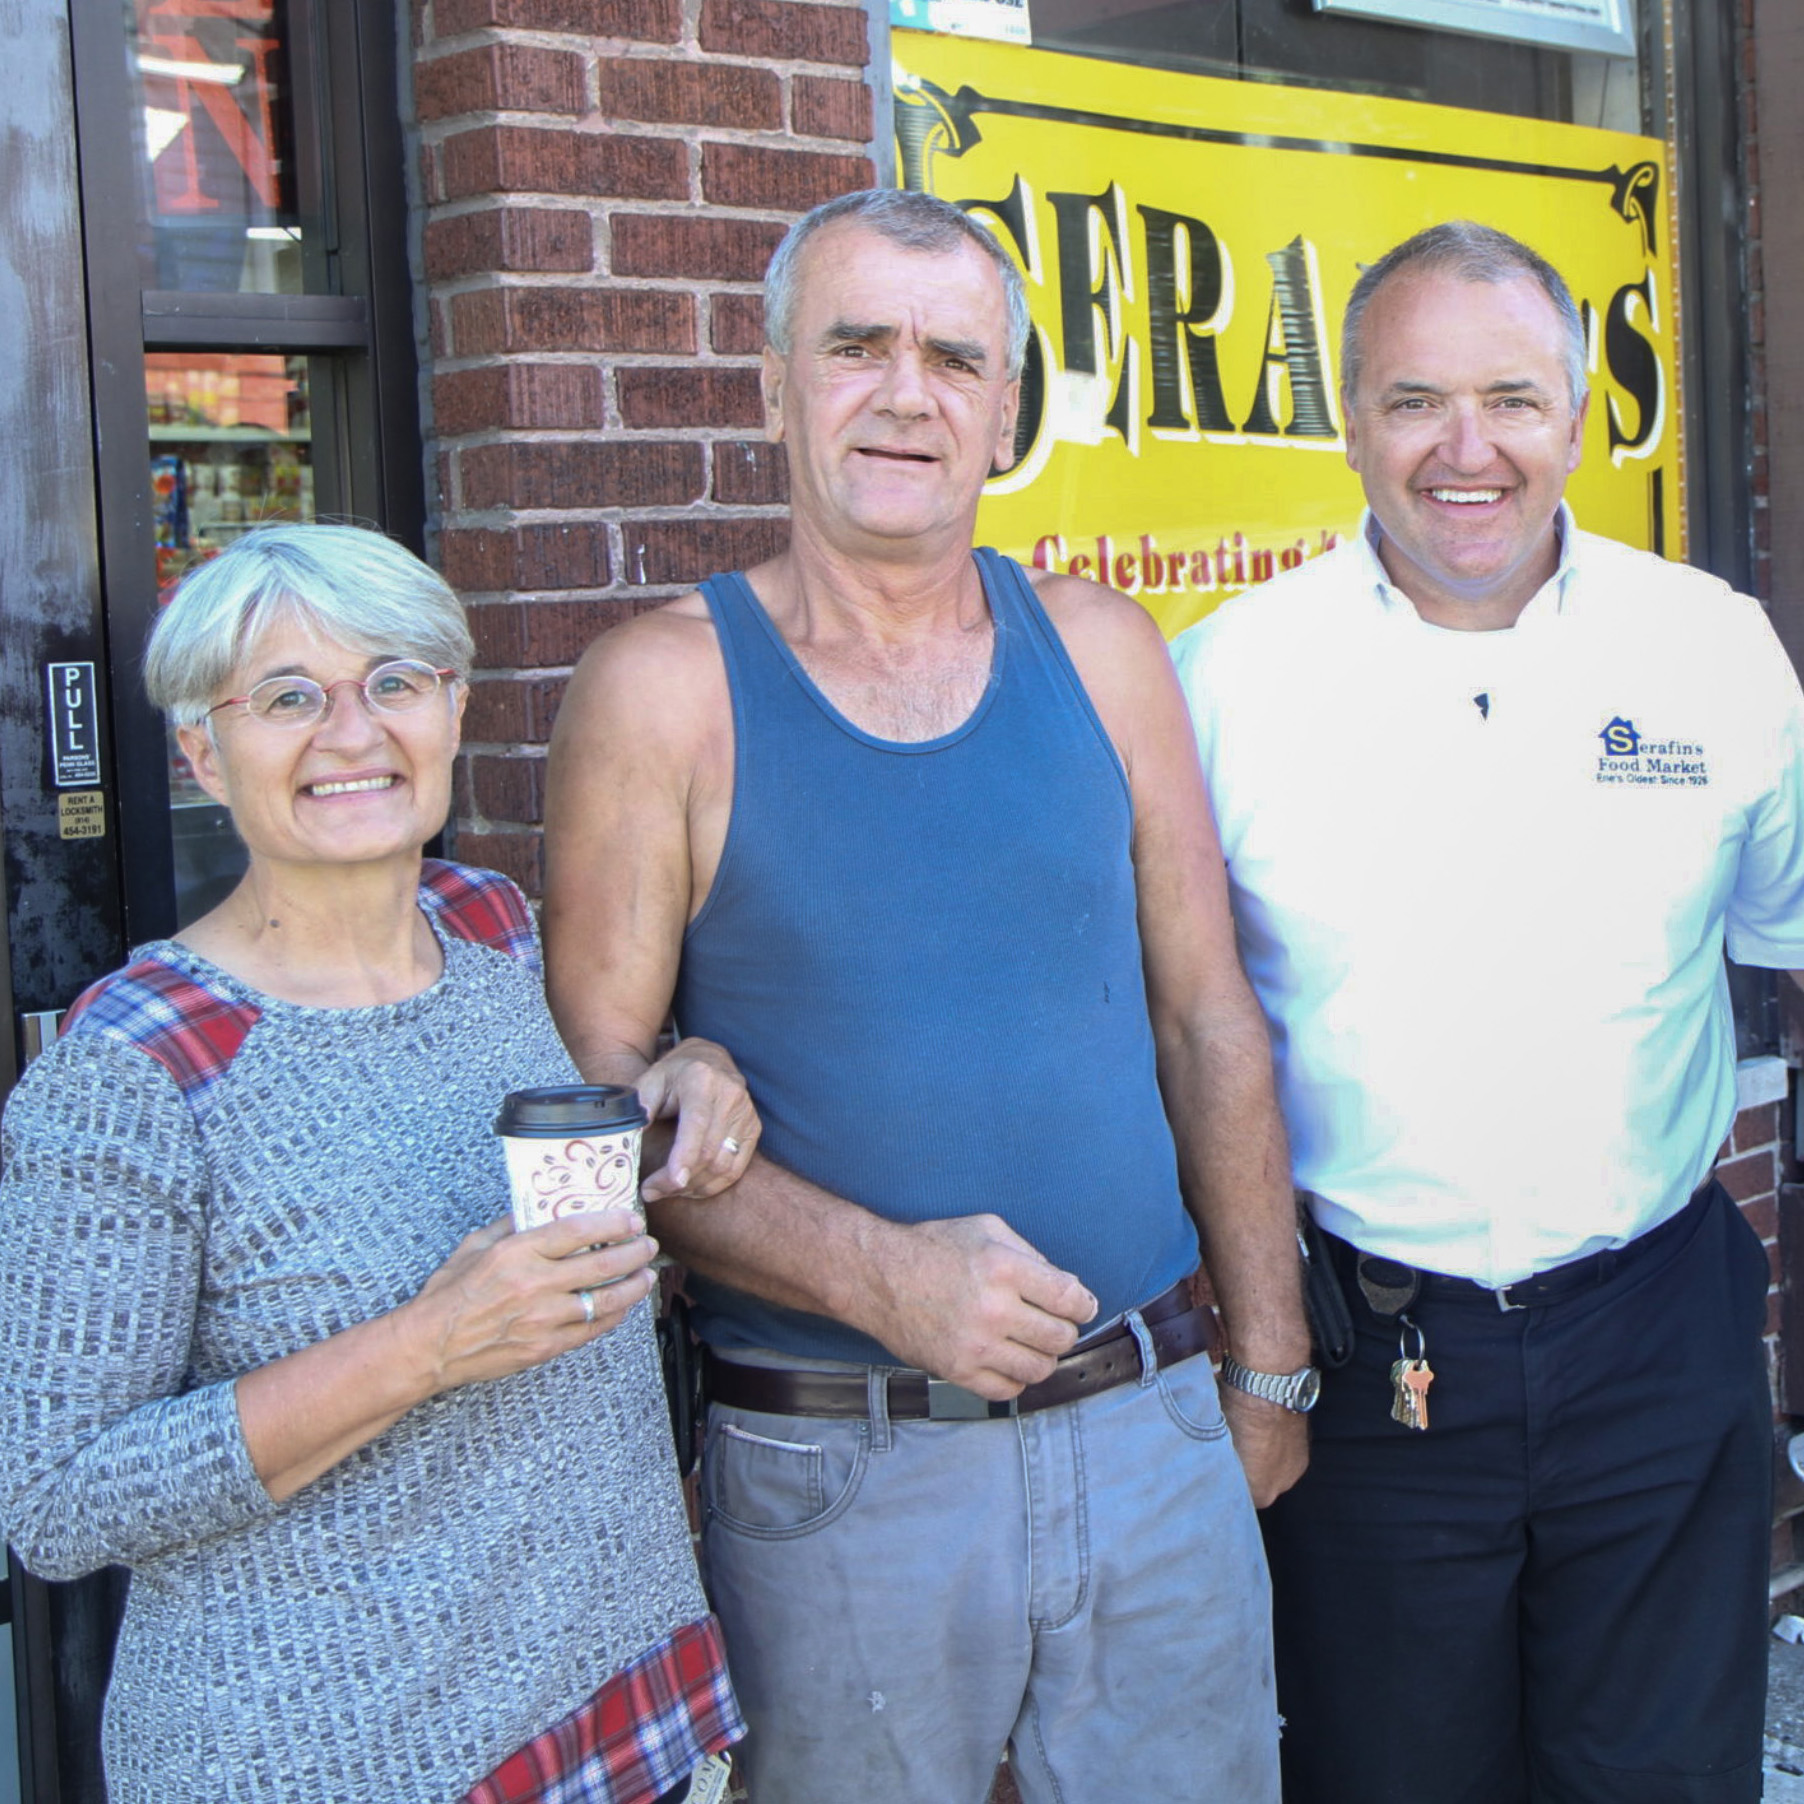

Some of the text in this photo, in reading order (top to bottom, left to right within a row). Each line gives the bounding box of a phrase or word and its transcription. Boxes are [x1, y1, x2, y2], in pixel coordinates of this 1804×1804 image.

[64, 667, 84, 750] PULL
[1598, 757, 1706, 774] Food Market
[1626, 773, 1657, 784] Oldest
[1660, 774, 1685, 785] Since
[67, 795, 95, 804] RENT A
[61, 805, 103, 816] LOCKSMITH
